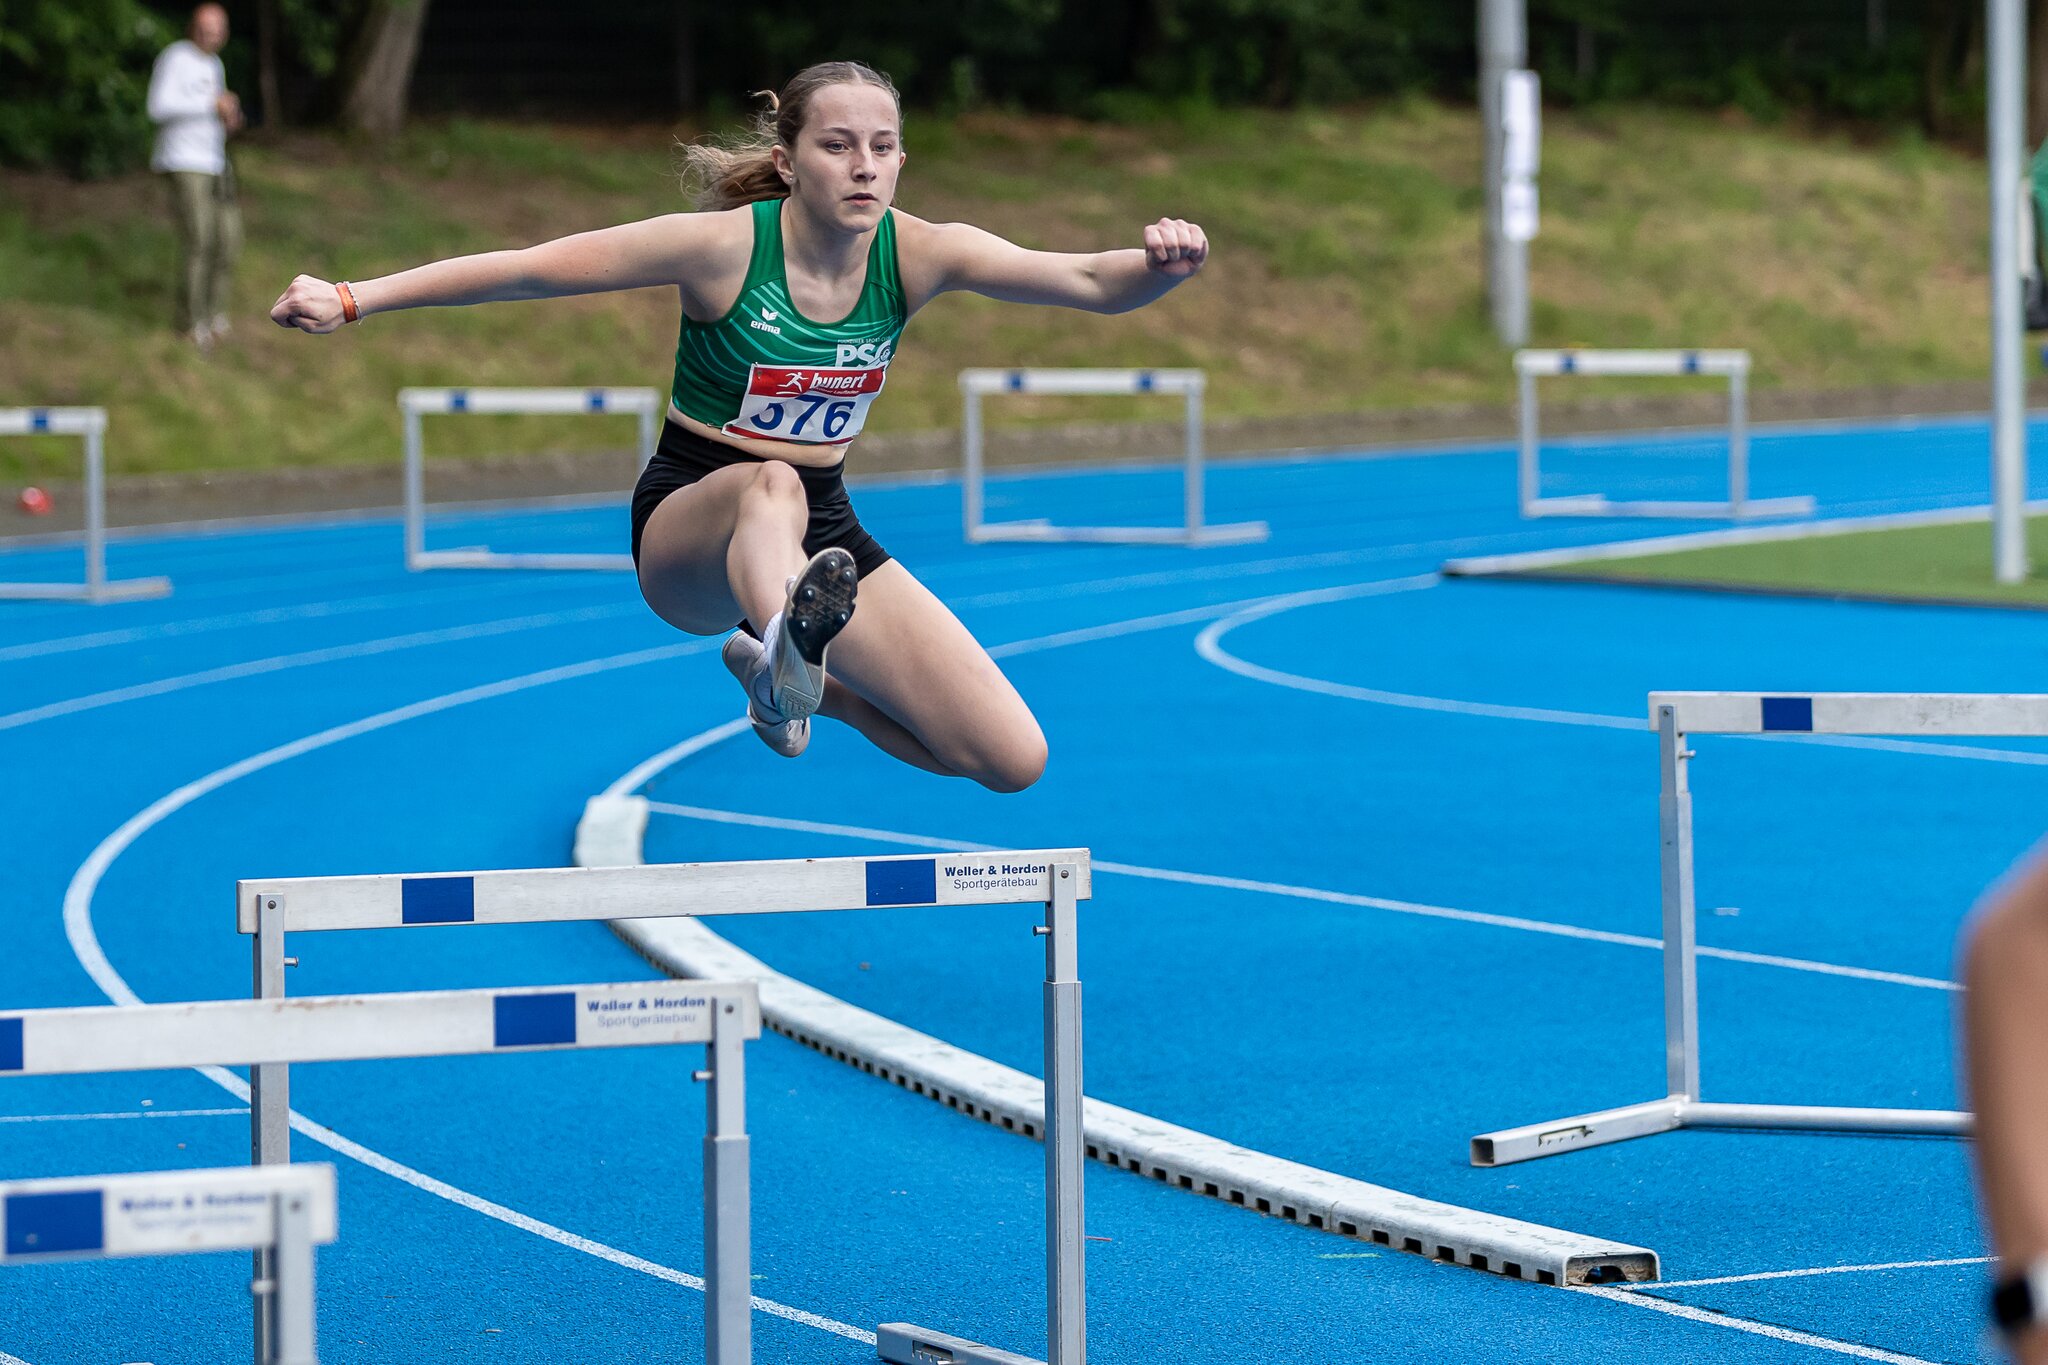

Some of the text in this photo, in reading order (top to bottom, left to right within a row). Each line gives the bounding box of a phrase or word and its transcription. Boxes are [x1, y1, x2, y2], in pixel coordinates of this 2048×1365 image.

[750, 320, 781, 335] erima
[945, 864, 1047, 877] Weller & Herden
[953, 877, 1038, 891] Sportgerätebau
[587, 997, 706, 1011] Weller & Herden
